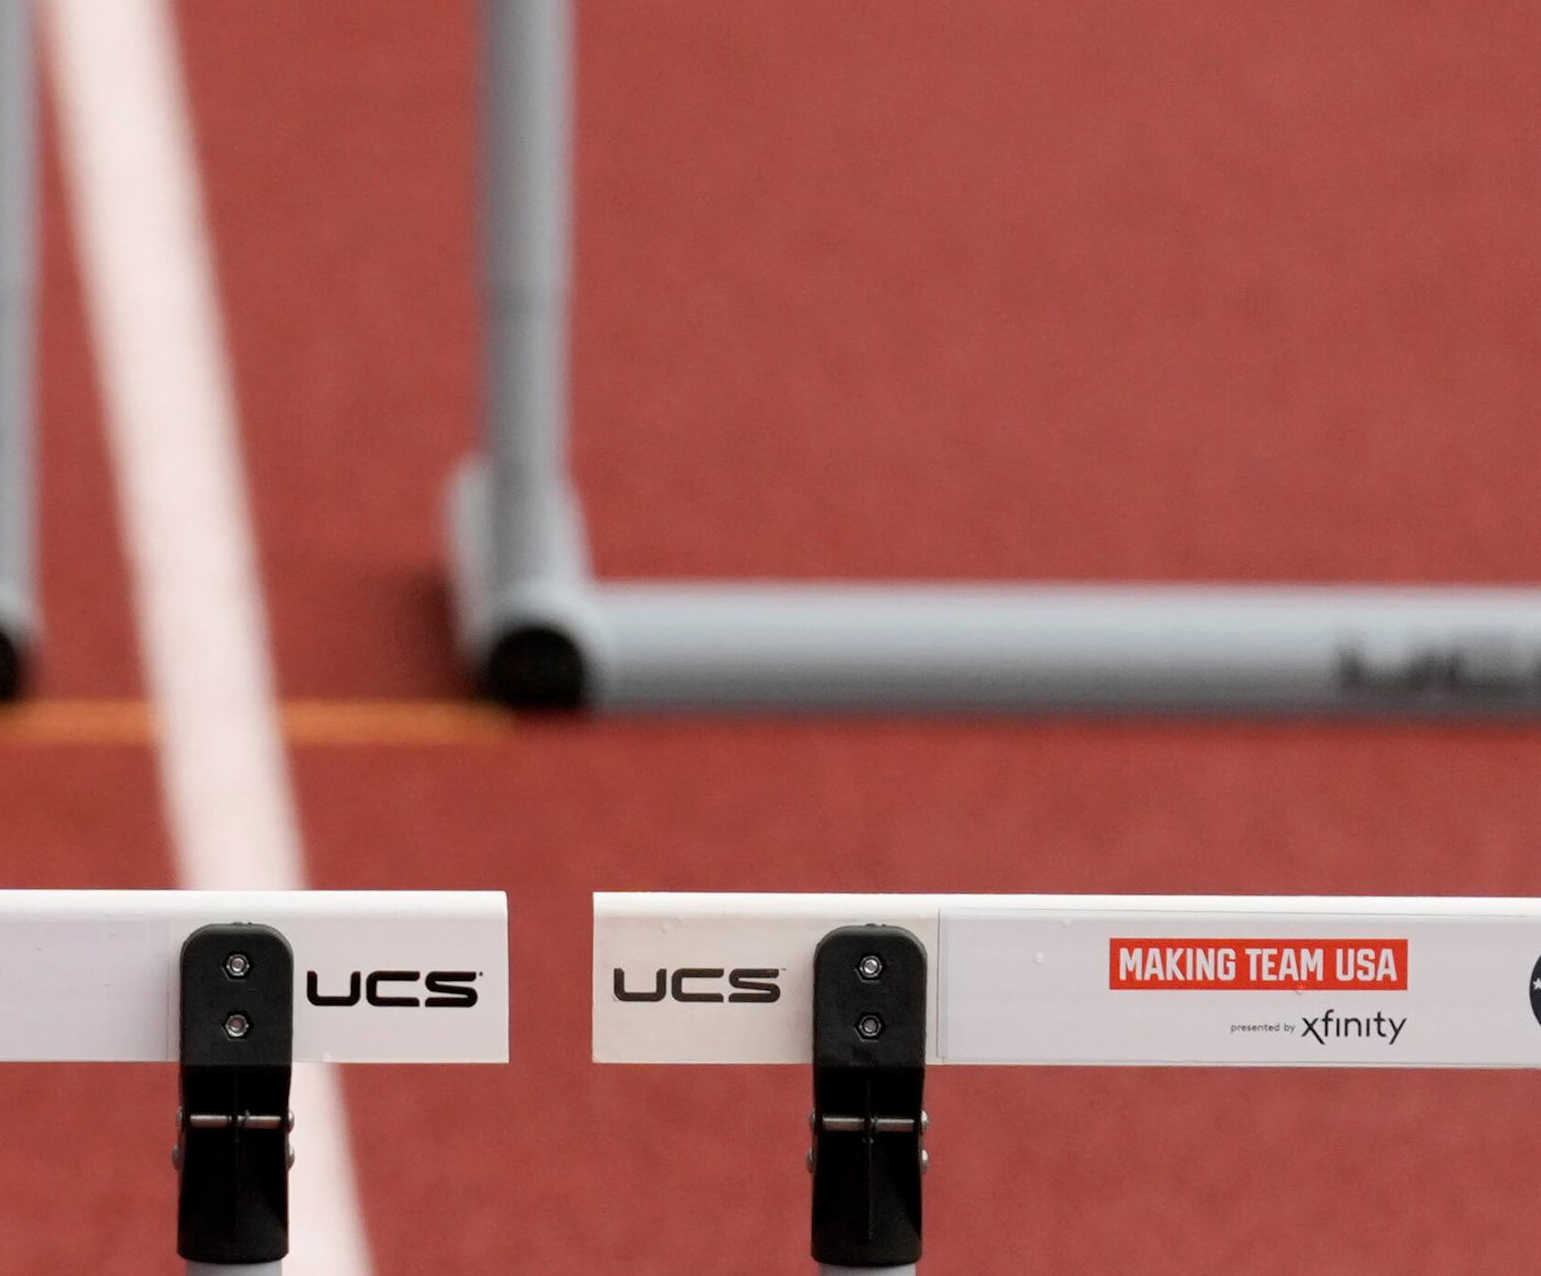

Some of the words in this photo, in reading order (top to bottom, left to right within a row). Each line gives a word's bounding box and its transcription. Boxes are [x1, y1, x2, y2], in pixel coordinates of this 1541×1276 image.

[1119, 947, 1237, 981] MAKING
[1244, 948, 1324, 982] TEAM
[1335, 948, 1398, 982] USA
[306, 970, 480, 1009] UCS
[613, 967, 783, 1004] UCS
[1230, 1022, 1280, 1034] presented
[1284, 1022, 1296, 1034] by
[1301, 1008, 1407, 1045] xfinity
